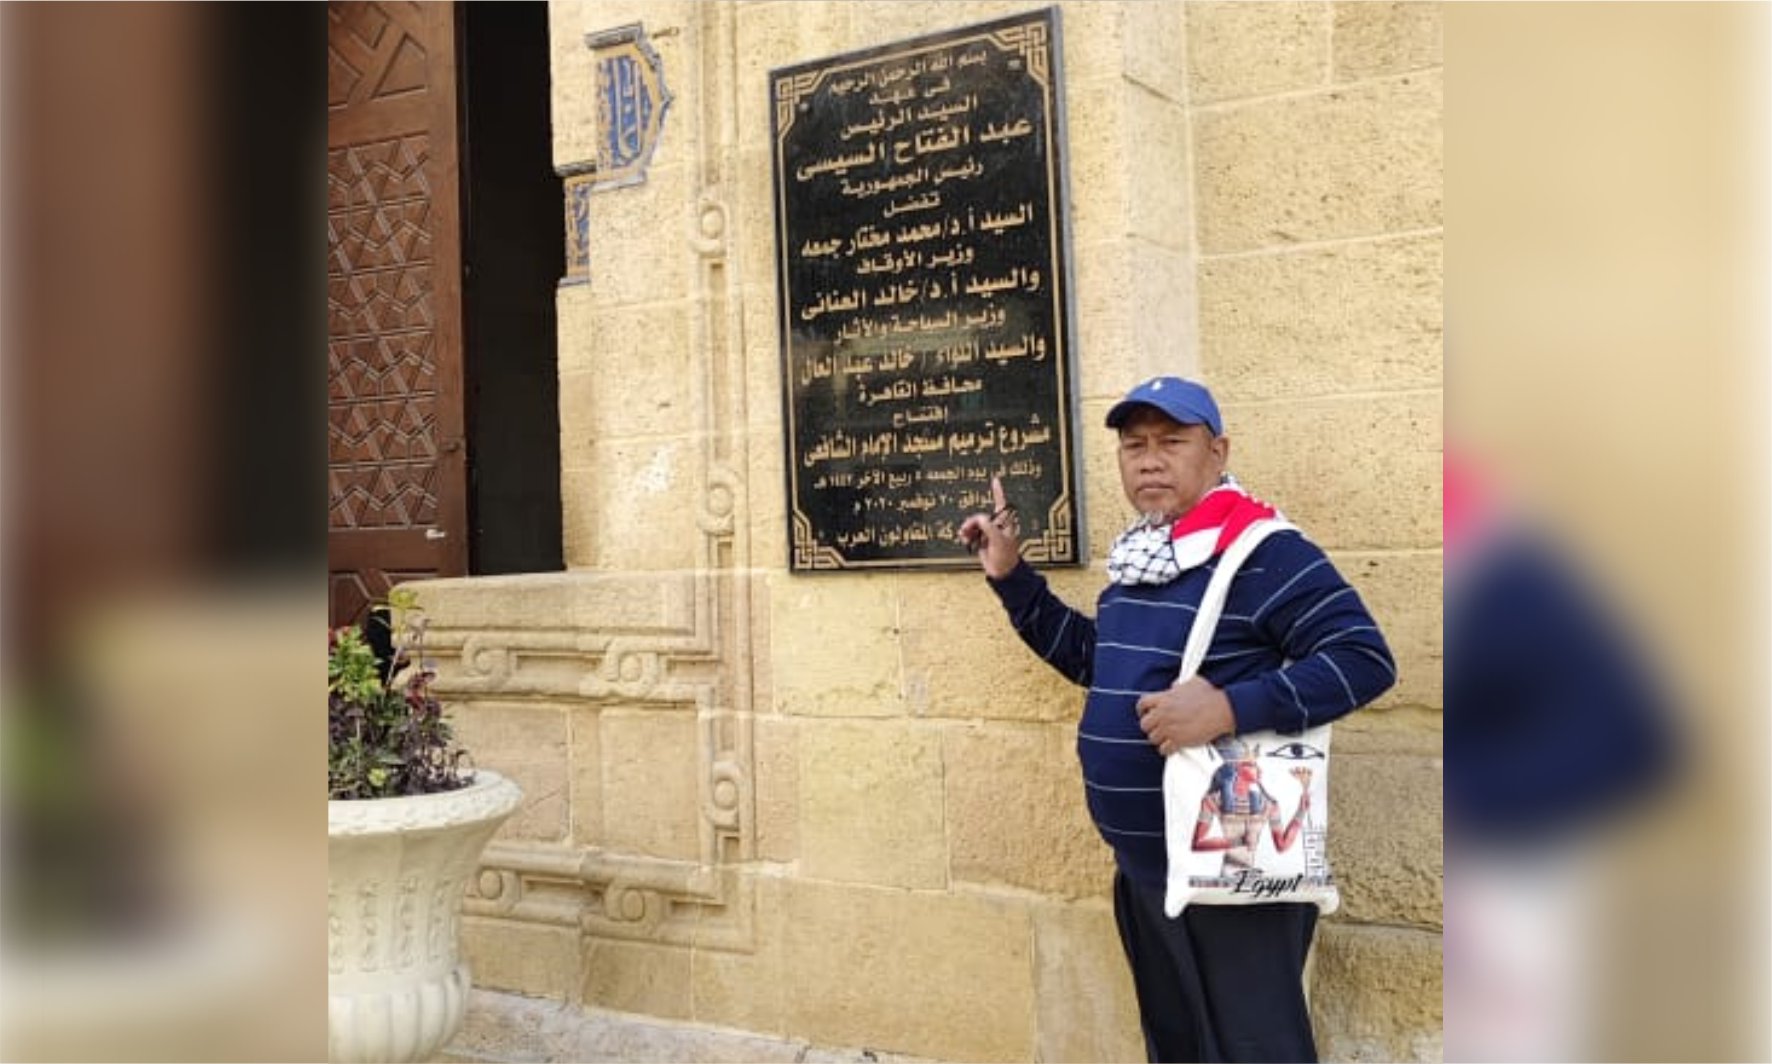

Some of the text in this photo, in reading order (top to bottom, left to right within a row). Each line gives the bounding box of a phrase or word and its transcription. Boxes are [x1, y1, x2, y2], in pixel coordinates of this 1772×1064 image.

[929, 55, 953, 72] الله
[840, 93, 978, 141] السيد الرئيس
[979, 118, 1033, 145] عبد
[894, 125, 970, 164] الفتاح
[840, 156, 984, 198] رئيس الجمهورية
[883, 191, 941, 219] تفضل
[980, 201, 1034, 232] السيد
[845, 223, 891, 256] مختار
[926, 242, 975, 269] وزير
[966, 265, 1041, 298] والسيد
[963, 303, 1006, 330] وزير
[984, 332, 1046, 365] والسيد
[902, 434, 944, 461] مسجد
[948, 420, 995, 461] ترميم
[999, 412, 1051, 454] مشروع
[837, 525, 876, 549] العرب
[1231, 868, 1303, 898] Egypt
